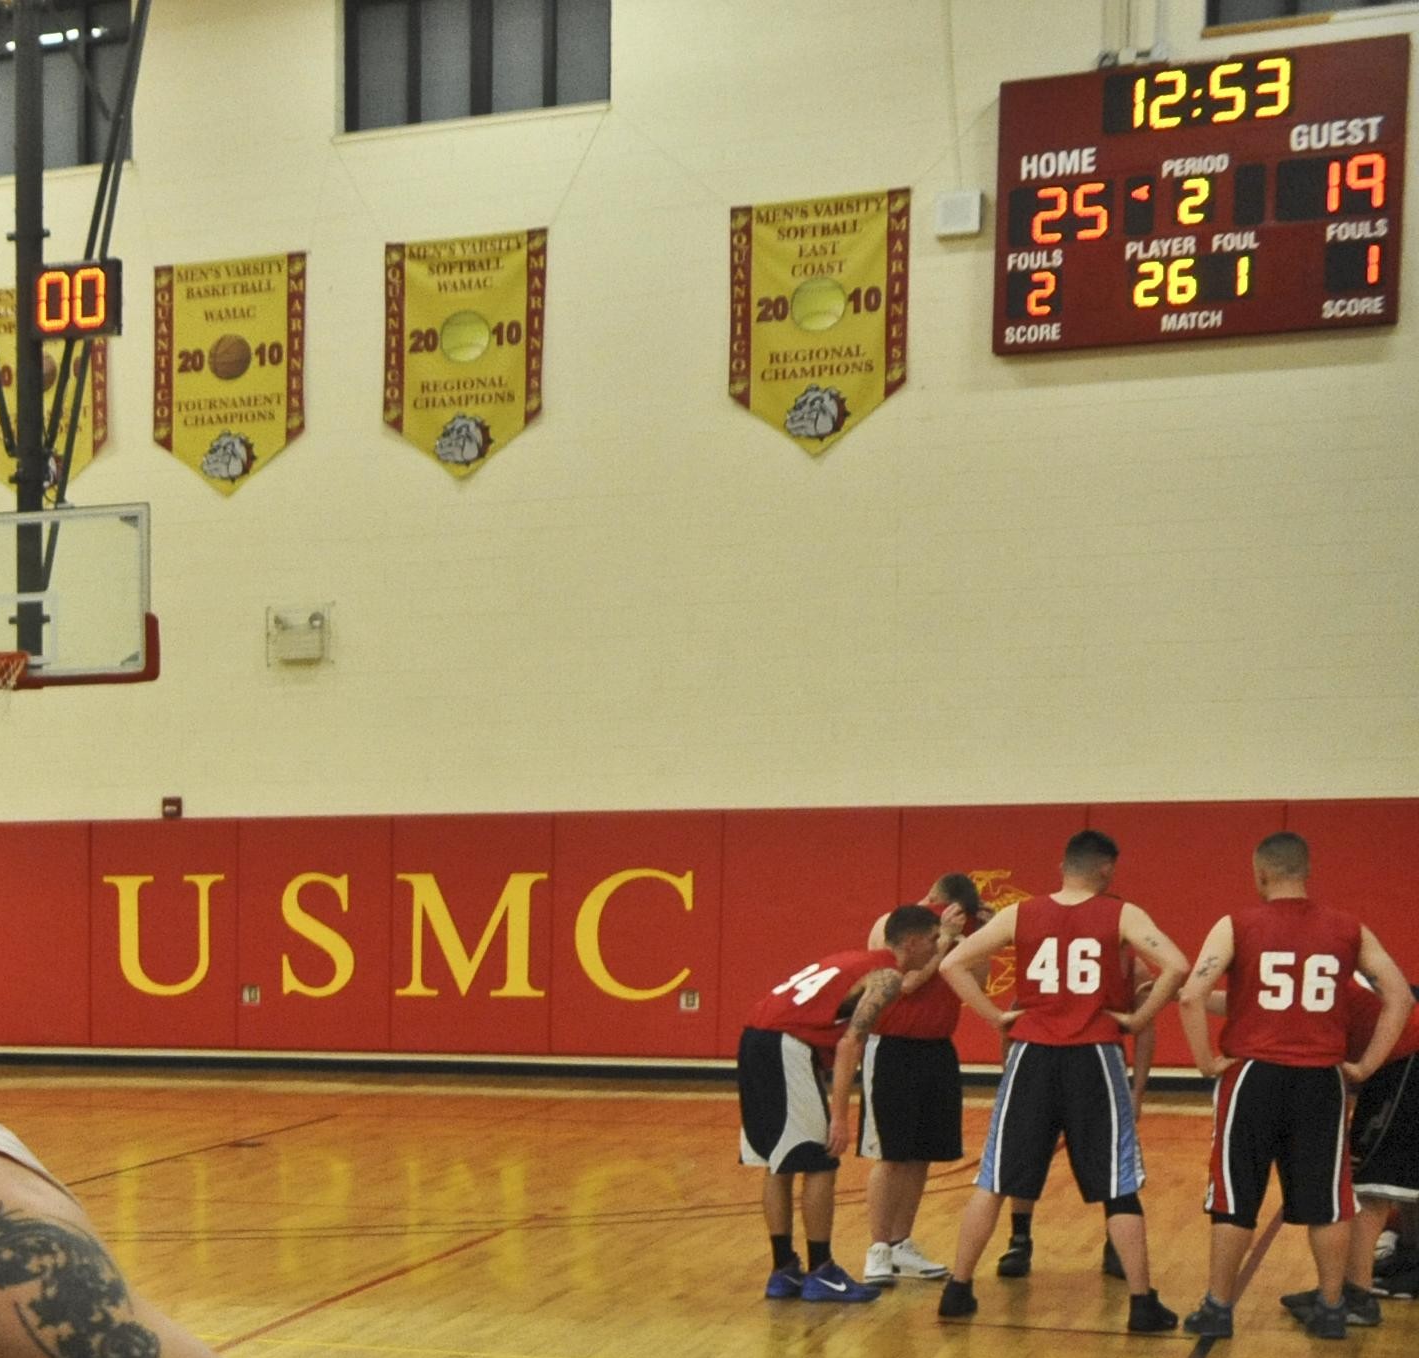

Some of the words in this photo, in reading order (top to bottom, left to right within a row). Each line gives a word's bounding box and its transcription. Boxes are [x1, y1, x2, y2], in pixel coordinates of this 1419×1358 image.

[1132, 56, 1292, 131] 12:53
[1290, 116, 1385, 152] GUEST
[1020, 147, 1097, 181] HOME
[1162, 154, 1229, 178] PERIOD
[1326, 152, 1387, 213] 19
[755, 206, 809, 226] MEN'S
[814, 197, 886, 218] VARSITY
[1032, 183, 1108, 244] 25
[1177, 178, 1210, 225] 2
[777, 218, 861, 241] SOFTBALL
[1326, 220, 1388, 242] FOULS
[798, 241, 838, 258] EAST
[1007, 248, 1063, 271] FOULS
[1125, 236, 1196, 261] PLAYER
[1212, 231, 1260, 252] FOUL
[177, 266, 221, 283] MEN'S
[225, 259, 285, 278] VARSITY
[427, 257, 505, 277] SOFTBALL
[791, 260, 847, 278] COAST
[1367, 244, 1380, 285] 1
[186, 279, 275, 300] BASKETBALL
[437, 276, 493, 293] WAMAC
[890, 216, 908, 358] MARINES
[1026, 271, 1056, 317] 2
[1133, 258, 1197, 308] 26
[1237, 256, 1249, 297] 1
[37, 267, 106, 332] 00
[732, 233, 748, 373] QUANTICO
[757, 295, 788, 323] 20
[848, 286, 882, 314] 10
[1322, 296, 1384, 319] SCORE
[1004, 323, 1061, 345] SCORE
[1161, 310, 1222, 333] MATCH
[409, 328, 439, 354] 20
[492, 320, 522, 346] 10
[178, 349, 204, 374] 20
[255, 341, 284, 366] 10
[769, 345, 866, 365] REGIONAL
[420, 376, 508, 394] REGIONAL
[761, 359, 875, 382] CHAMPIONS
[177, 393, 284, 413] TOURNAMENT
[413, 390, 516, 410] CHAMPIONS
[184, 409, 276, 427] CHAMPIONS
[103, 868, 693, 1000] USMC
[1026, 937, 1101, 995] 46
[1258, 951, 1339, 1011] 56
